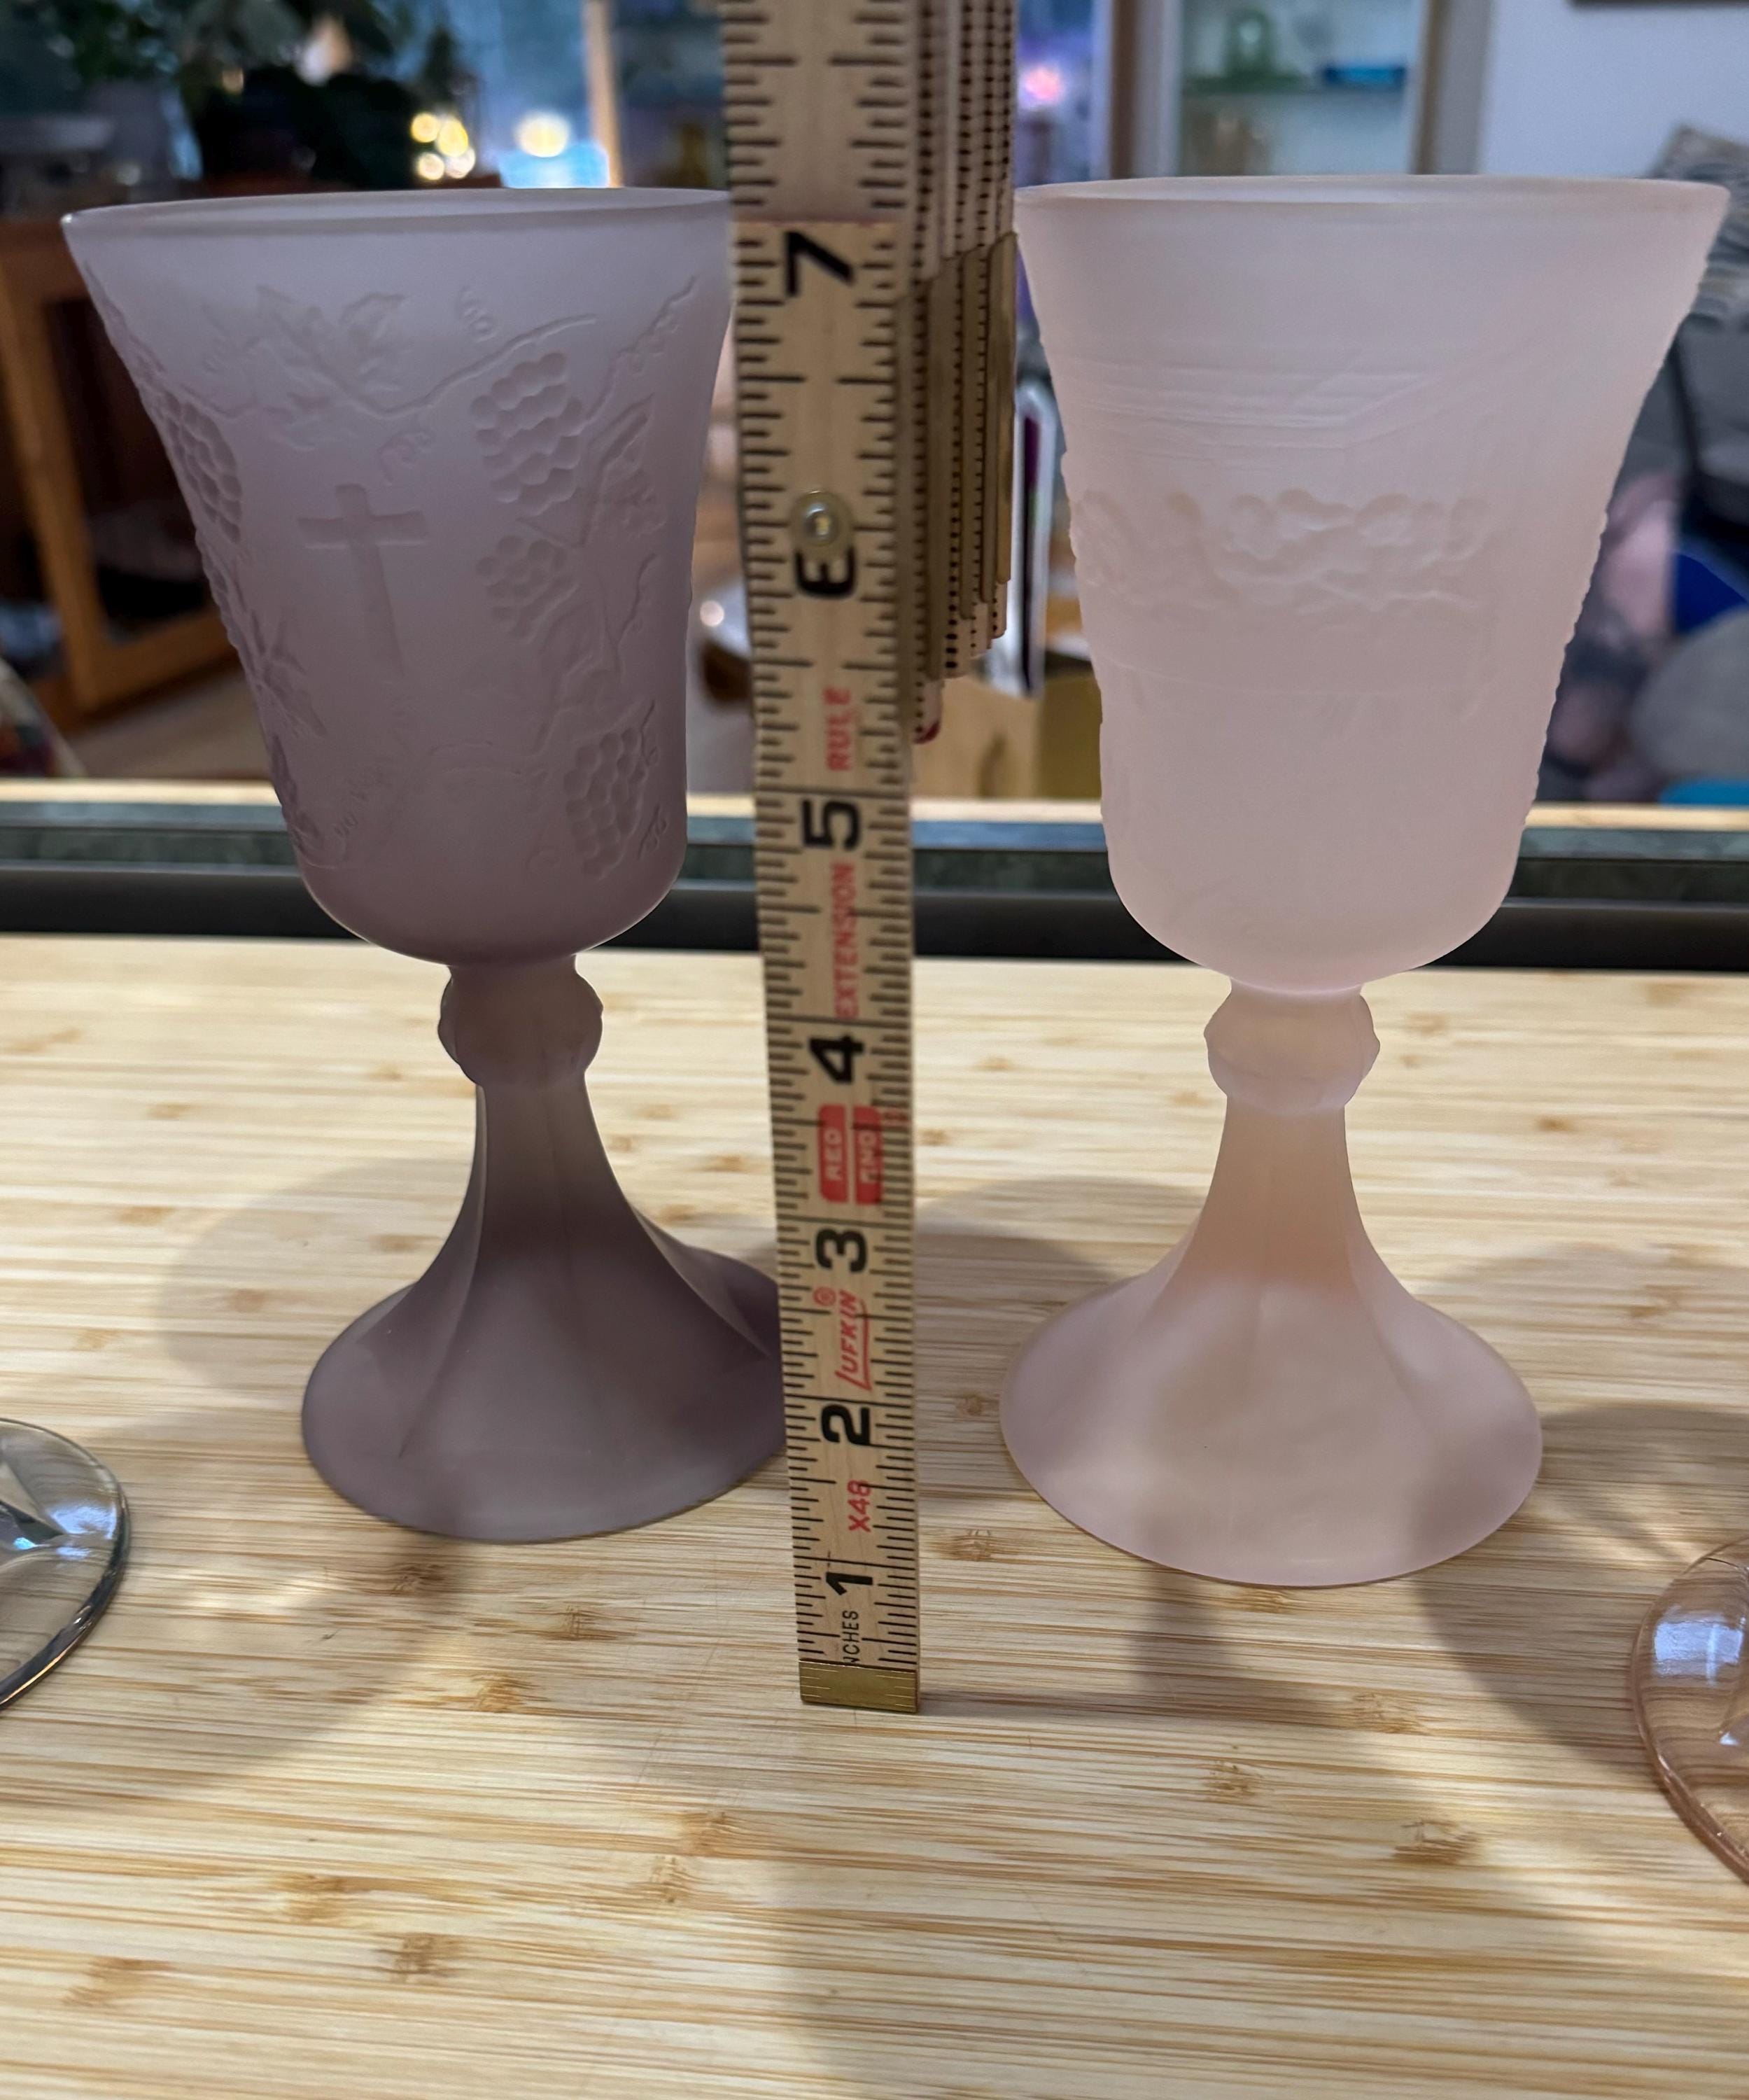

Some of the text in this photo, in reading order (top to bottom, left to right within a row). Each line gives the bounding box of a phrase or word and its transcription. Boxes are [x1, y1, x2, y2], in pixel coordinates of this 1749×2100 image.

[787, 230, 855, 296] 7
[823, 687, 852, 771] RULE
[801, 799, 862, 850] 5
[831, 862, 859, 1019] EXTENSION
[808, 1034, 865, 1084] 4
[824, 1128, 843, 1181] RED
[815, 1228, 867, 1273] 3
[835, 1289, 872, 1393] LUFKIN
[820, 1404, 871, 1446] 2
[847, 1479, 872, 1533] X48
[825, 1572, 873, 1596] 1
[842, 1609, 861, 1665] NCHES
